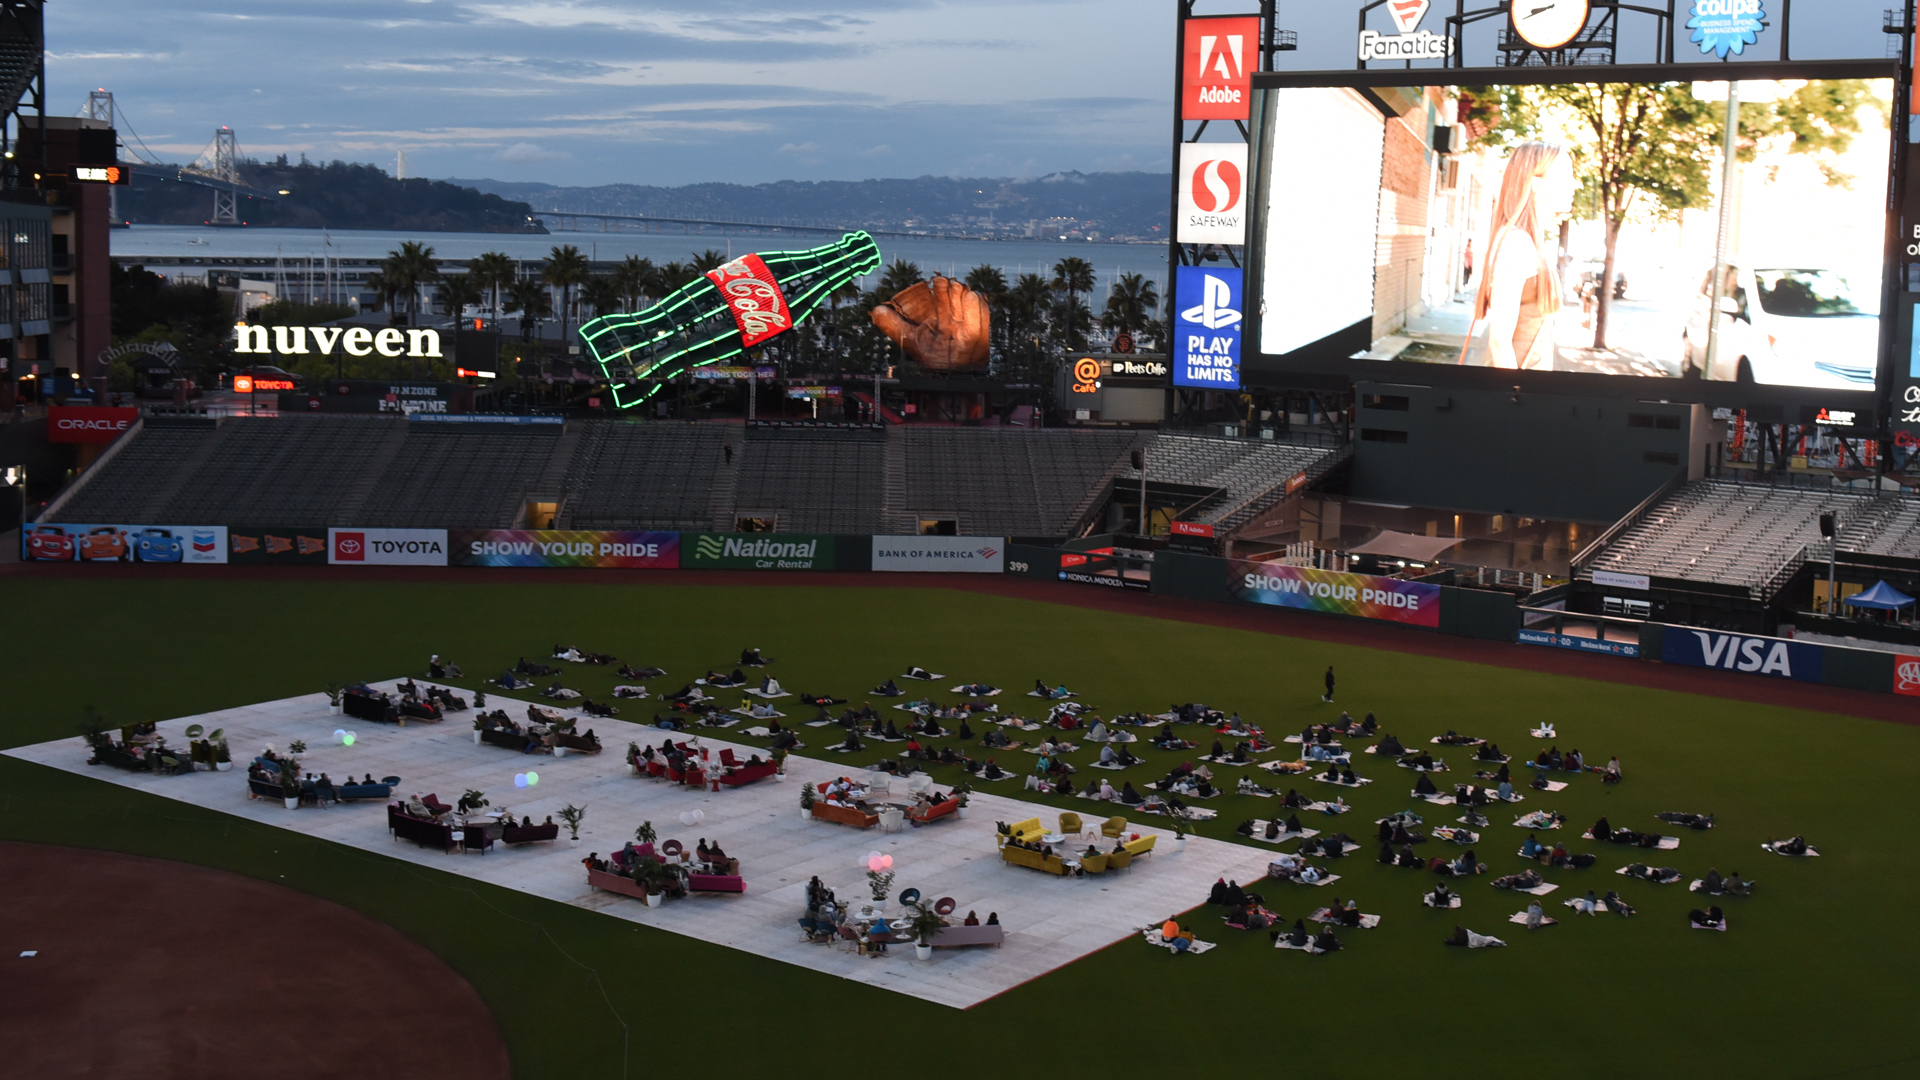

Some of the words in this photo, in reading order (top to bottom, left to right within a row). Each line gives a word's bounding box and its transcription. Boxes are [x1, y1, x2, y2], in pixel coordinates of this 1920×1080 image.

[1696, 0, 1760, 20] coupa
[1363, 34, 1449, 55] Fanatics
[1199, 85, 1241, 103] Adobe
[1190, 215, 1239, 228] SAFEWAY
[234, 324, 443, 358] nuveen
[1188, 335, 1233, 355] PLAY
[98, 341, 181, 367] Ghirardelli
[1187, 354, 1212, 366] HAS
[1214, 356, 1233, 368] NO
[254, 379, 294, 390] TOYOTA
[410, 386, 437, 396] ZONE
[1072, 383, 1097, 393] Café
[58, 419, 128, 430] ORACLE
[1189, 526, 1205, 534] Adobe
[371, 541, 442, 555] TOYOTA
[471, 541, 533, 556] SHOW
[539, 542, 594, 557] YOUR
[600, 543, 659, 558] PRIDE
[723, 537, 816, 559] National
[878, 549, 907, 558] BANK
[910, 550, 923, 558] OF
[926, 550, 974, 559] AMERICA
[755, 560, 773, 569] Car
[777, 560, 812, 569] Rental
[1009, 561, 1029, 572] 399
[1067, 573, 1093, 583] KONICA
[1093, 576, 1124, 588] MINOLTA
[1245, 573, 1301, 594] SHOW
[1306, 581, 1357, 601] YOUR
[1362, 588, 1419, 610] PRIDE
[1519, 632, 1549, 643] Heineken
[1580, 640, 1611, 651] Heineken
[1691, 631, 1791, 677] VISA
